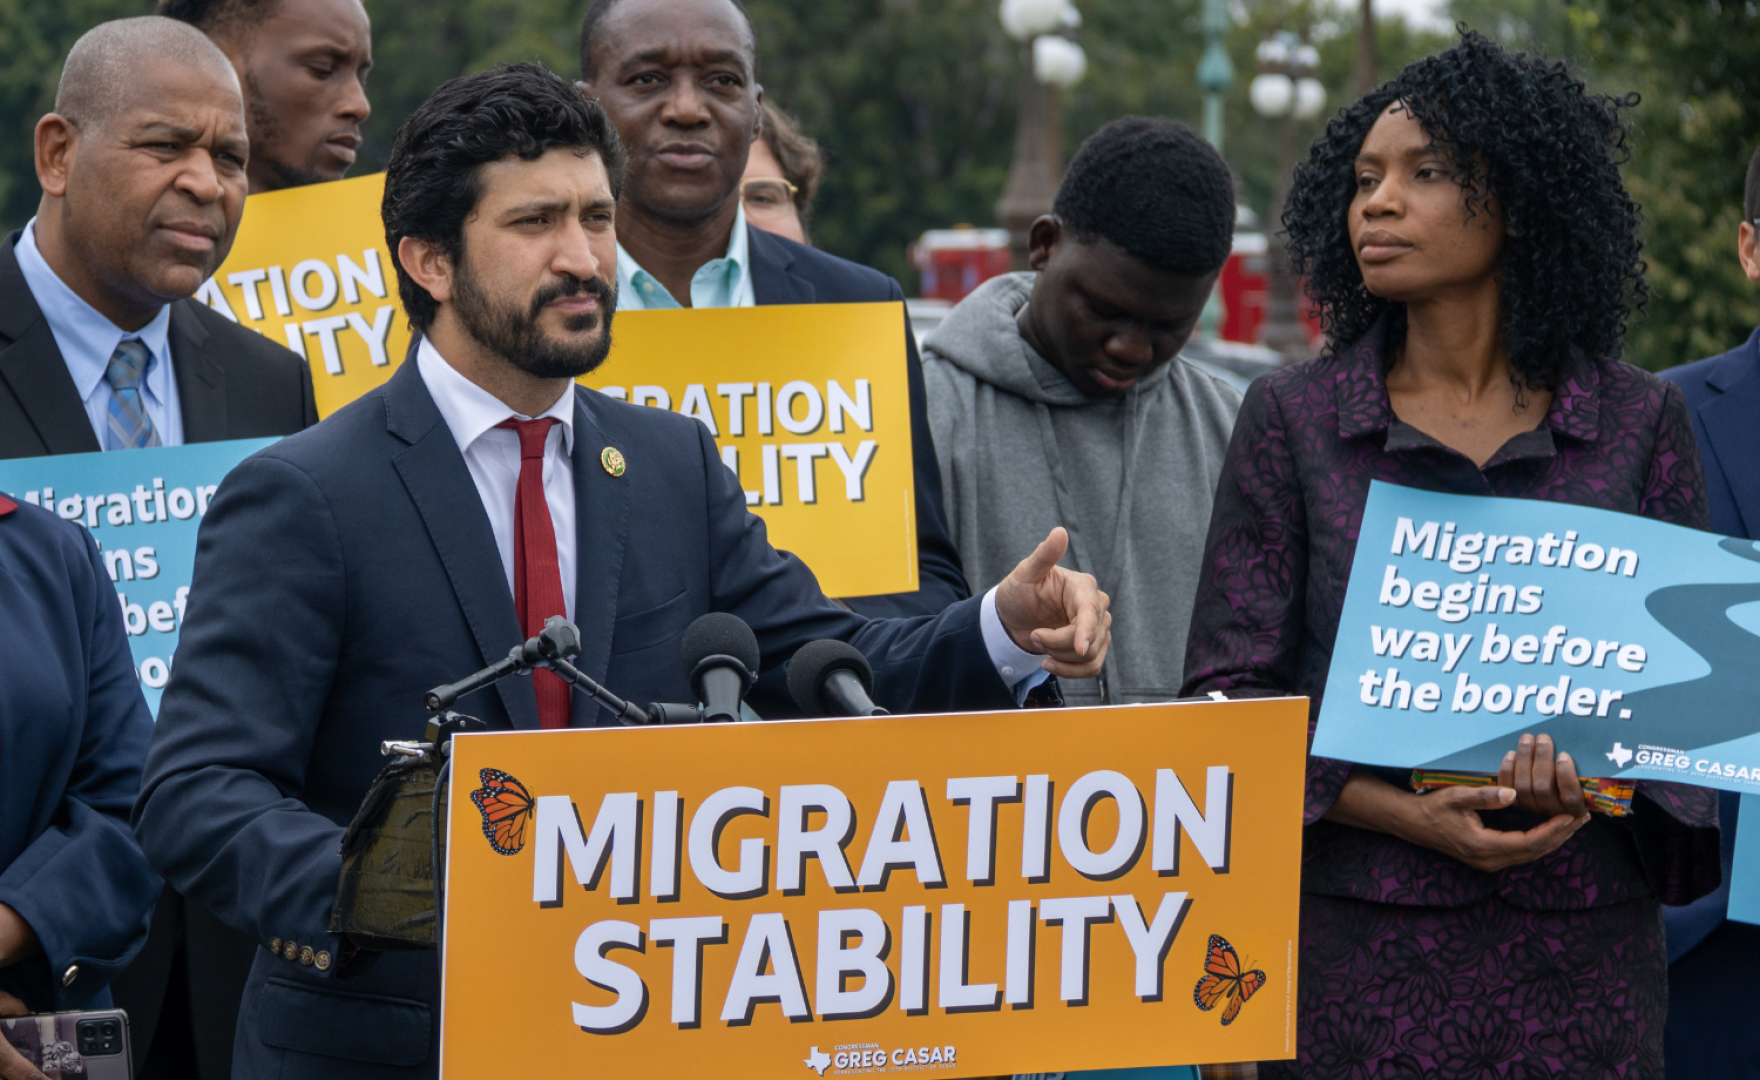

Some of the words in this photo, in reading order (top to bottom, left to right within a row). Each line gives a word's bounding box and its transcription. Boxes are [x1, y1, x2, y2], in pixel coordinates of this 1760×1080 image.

[196, 248, 387, 323] ATION
[1390, 516, 1640, 578] Migration
[1379, 564, 1545, 622] begins
[1370, 625, 1473, 673] way
[1479, 623, 1648, 673] before
[1359, 667, 1443, 712] the
[1451, 672, 1633, 720] border.
[1635, 750, 1691, 769] GREG
[1695, 759, 1760, 781] CASAR
[1638, 744, 1686, 755] CONGRESSMAN
[533, 766, 1231, 905] MIGRATION
[571, 892, 1192, 1033] STABILITY
[834, 1050, 888, 1069] GREG
[891, 1046, 957, 1066] CASAR
